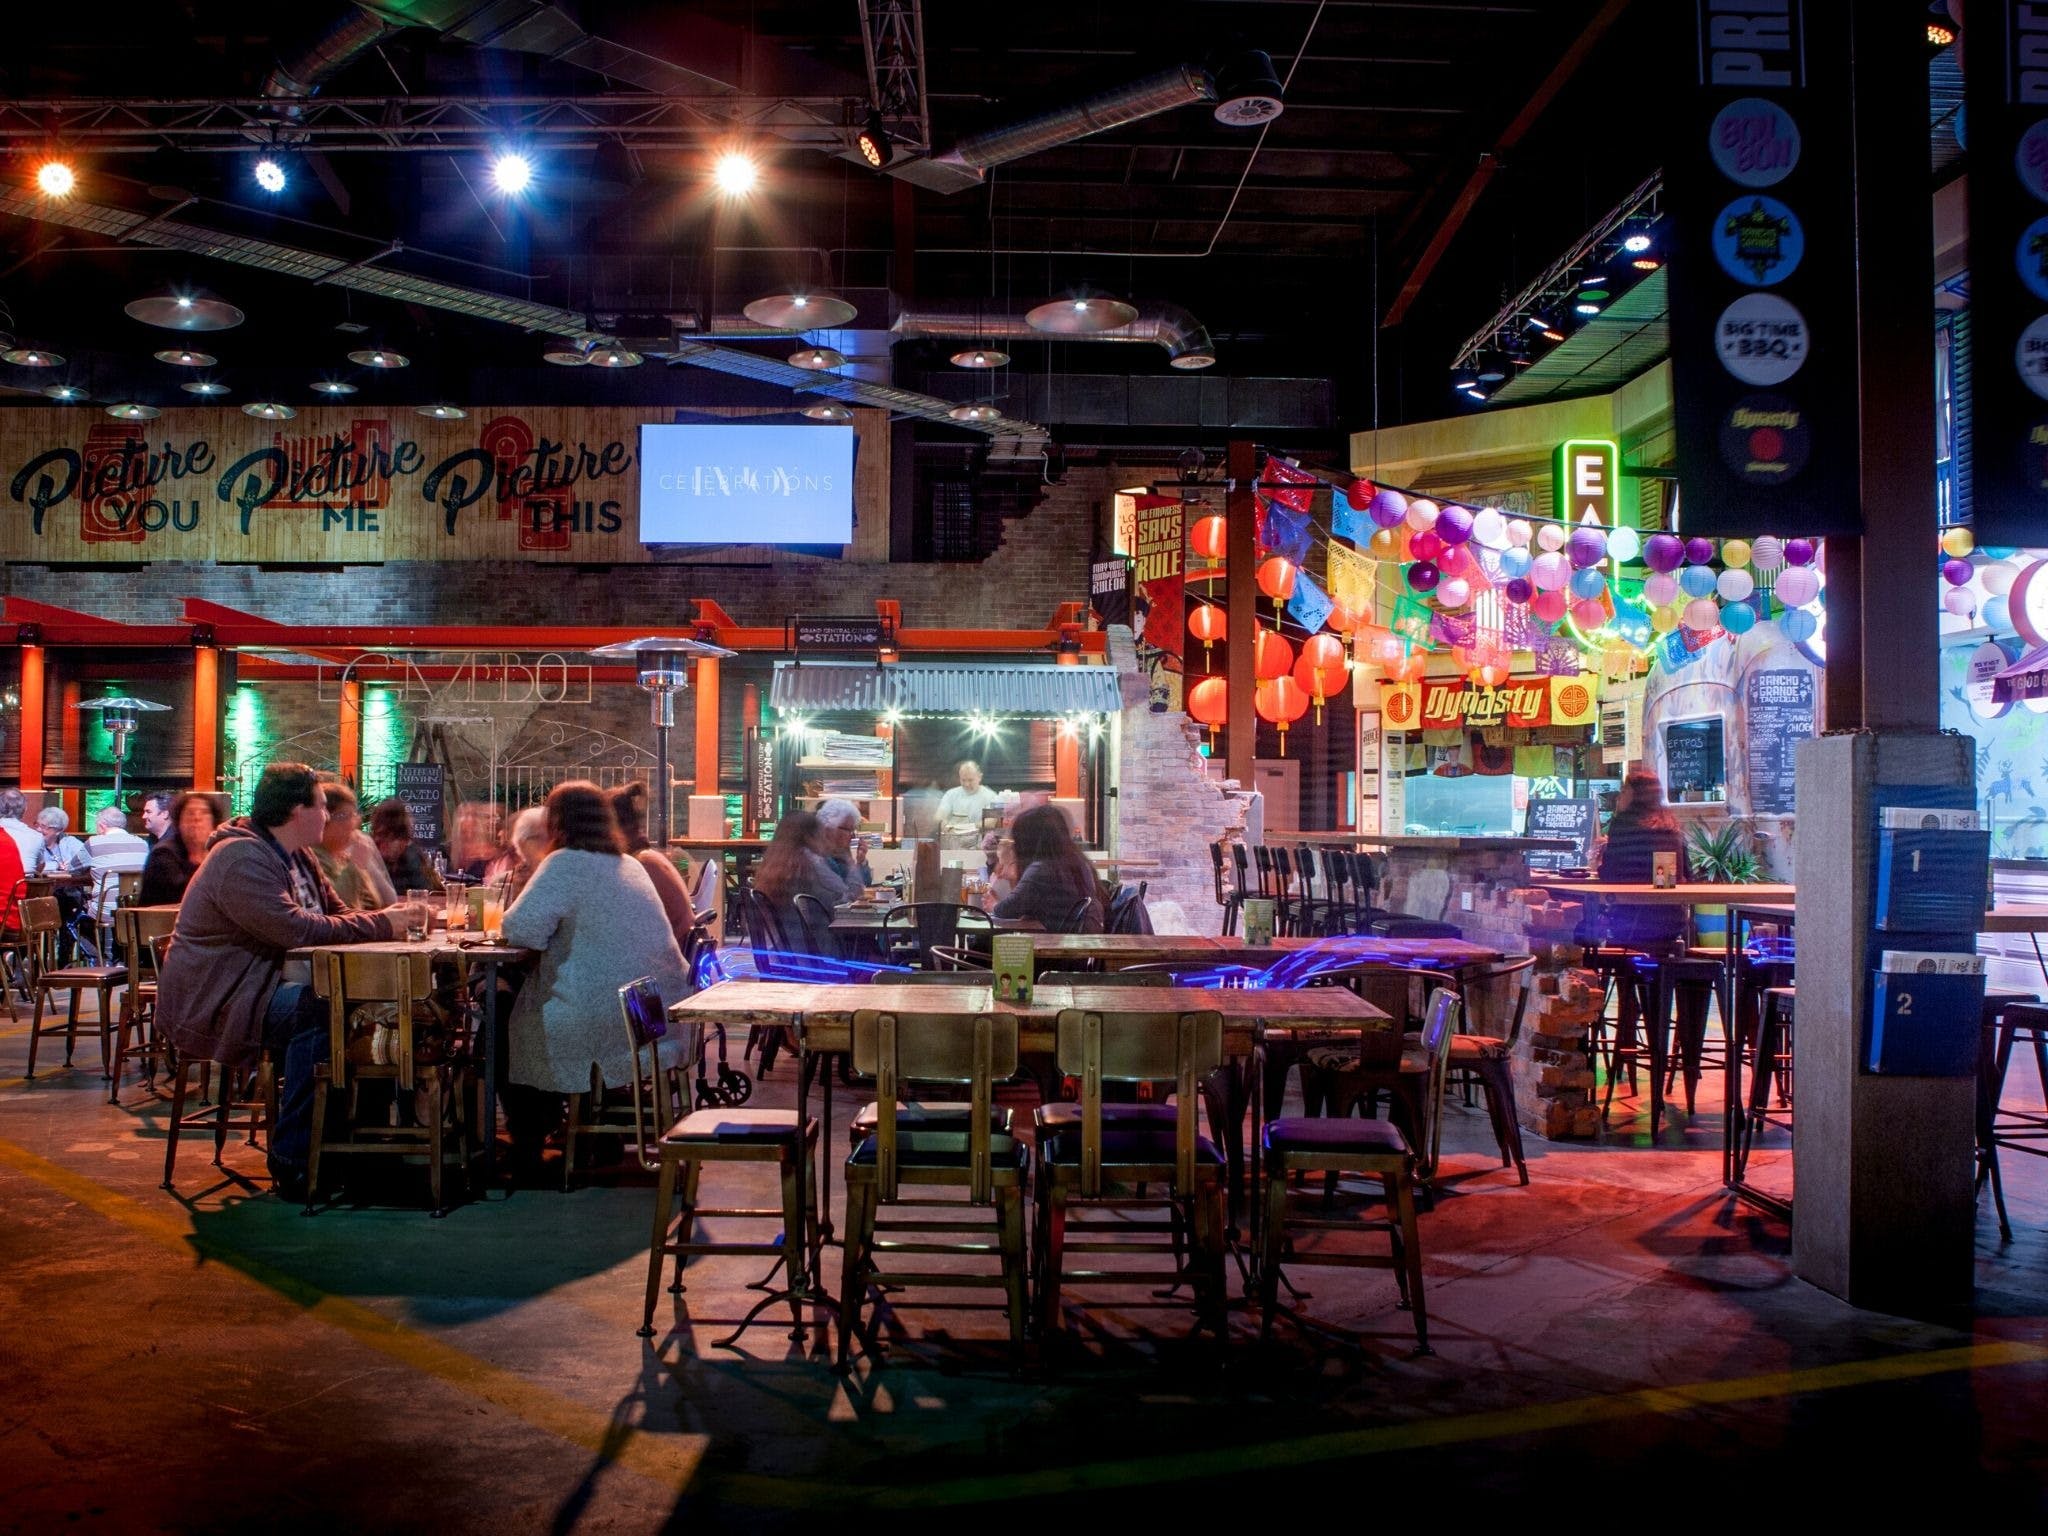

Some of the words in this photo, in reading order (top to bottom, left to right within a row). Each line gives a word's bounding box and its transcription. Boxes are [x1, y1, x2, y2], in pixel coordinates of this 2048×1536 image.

[1723, 323, 1754, 335] BIG
[1755, 323, 1800, 336] TIME
[1739, 339, 1789, 359] BBQ
[10, 437, 216, 535] Picture
[217, 432, 425, 535] Picture
[422, 436, 632, 535] Picture
[659, 474, 833, 491] CELEBRATIONS
[112, 500, 198, 532] YOU
[322, 502, 380, 532] ME
[528, 500, 622, 533] THIS
[1150, 504, 1182, 518] EMPRESS
[1138, 515, 1182, 543] SAYS
[1138, 539, 1181, 556] DUMPLINGS
[1093, 562, 1108, 573] MAY
[1109, 559, 1126, 571] YOUR
[1137, 550, 1181, 582] RULE
[1092, 579, 1113, 594] RULE
[1113, 577, 1126, 591] OK
[815, 633, 863, 643] STATION
[1759, 675, 1799, 686] RANCHO
[1759, 686, 1799, 697] GRANDE
[1424, 685, 1544, 721] Dynasty
[1667, 738, 1704, 748] EFTPOS
[1671, 749, 1698, 759] ONLY
[764, 757, 773, 804] STATION
[404, 805, 433, 813] EVENT
[1911, 849, 1921, 872] 1
[1897, 993, 1912, 1015] 2
